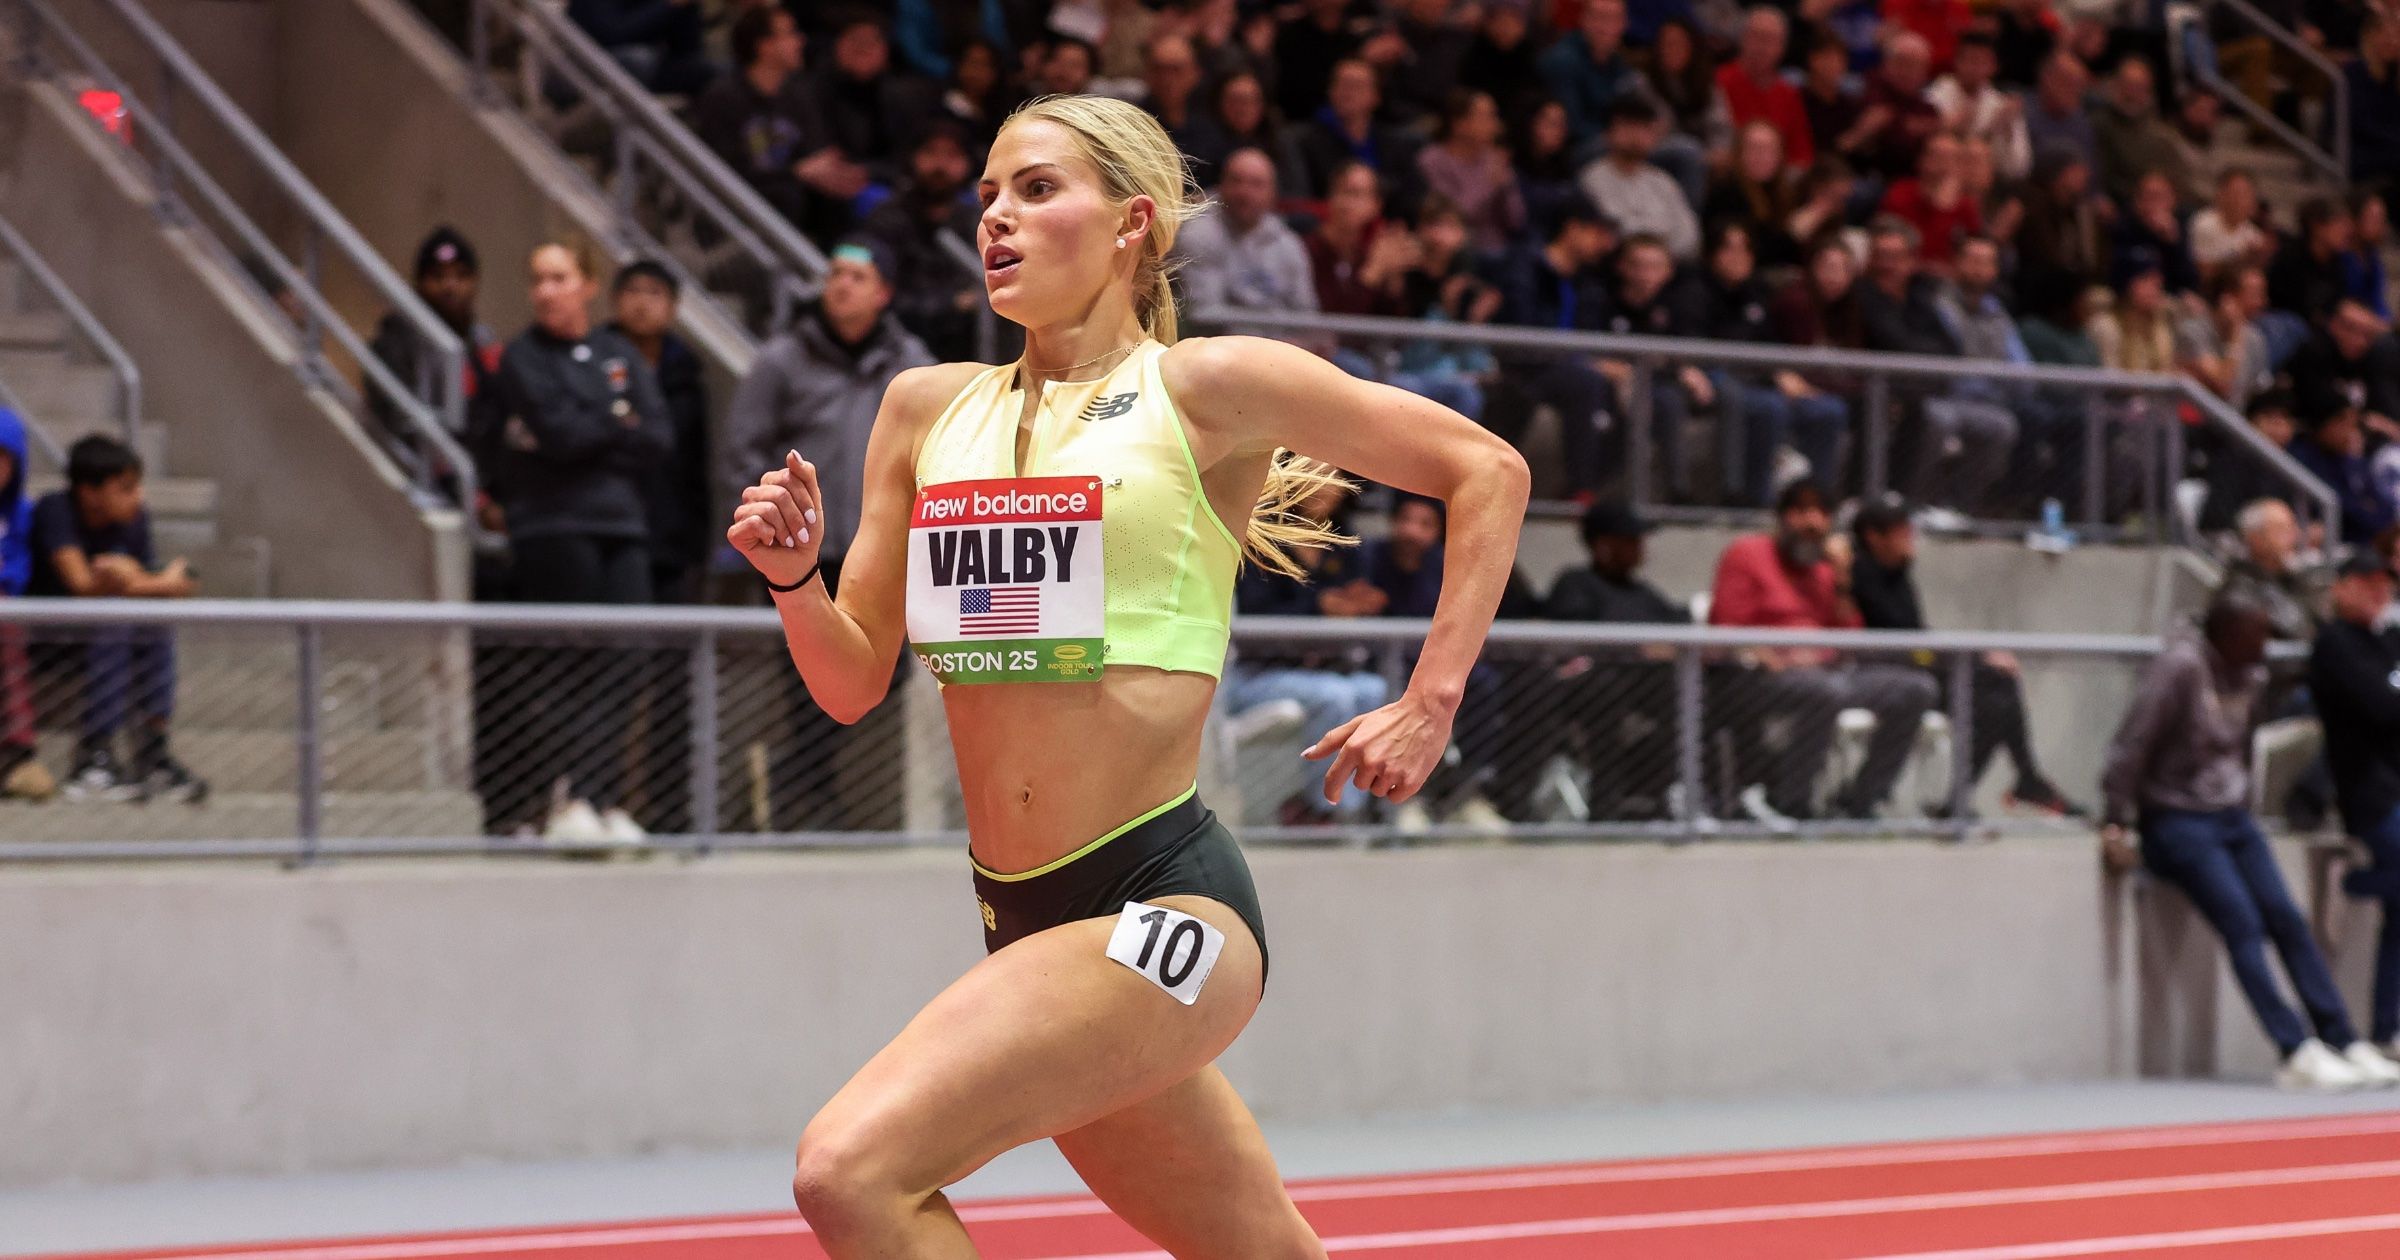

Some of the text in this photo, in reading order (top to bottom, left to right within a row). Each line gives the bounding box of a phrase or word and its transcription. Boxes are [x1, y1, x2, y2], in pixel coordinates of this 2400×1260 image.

[921, 489, 1088, 520] new balance
[928, 526, 1080, 587] VALBY
[1008, 650, 1038, 671] 25
[1047, 662, 1073, 670] INDOOR
[1060, 668, 1080, 676] GOLD
[1136, 909, 1204, 988] 10
